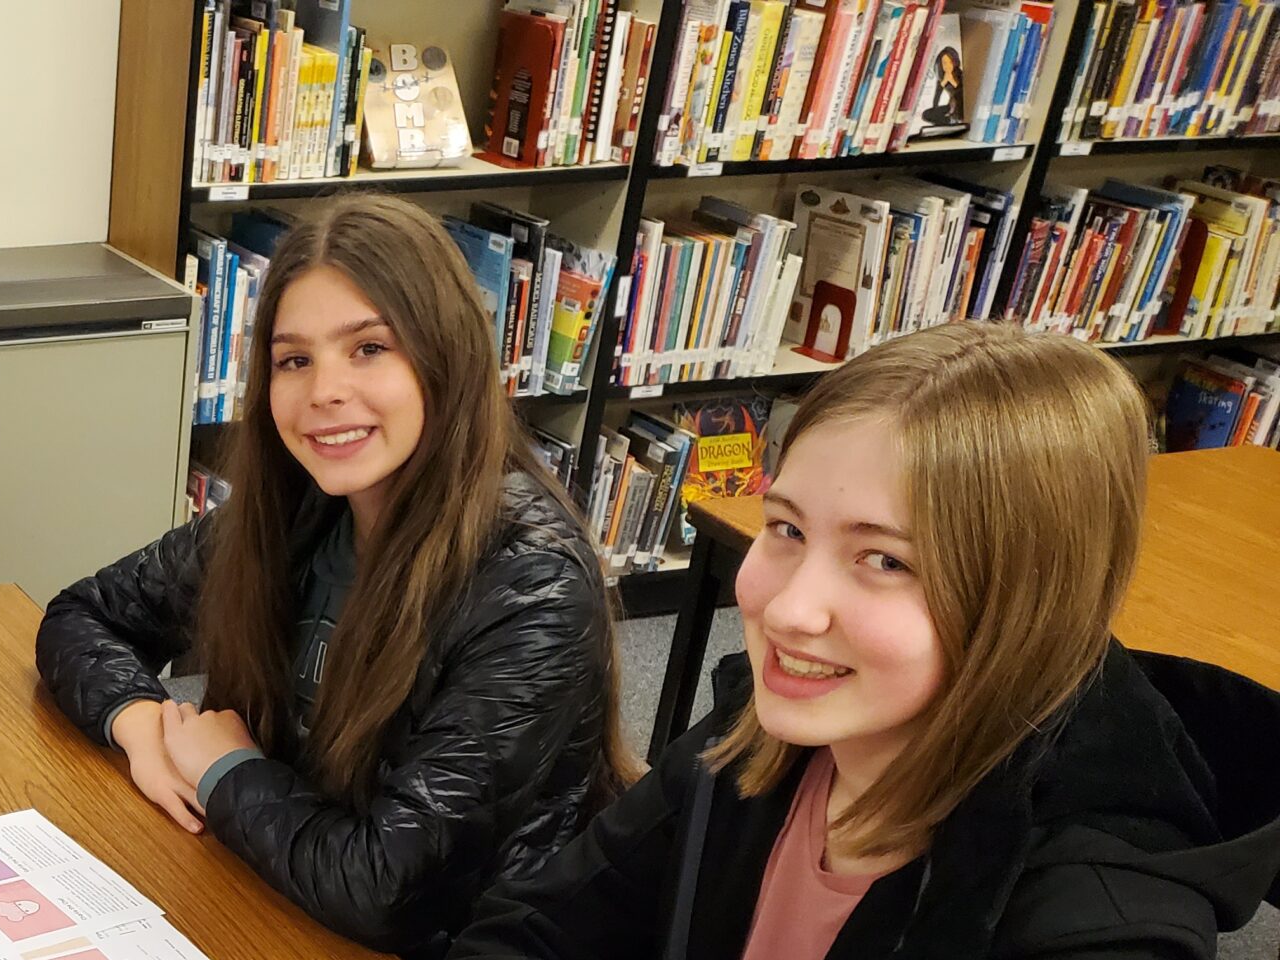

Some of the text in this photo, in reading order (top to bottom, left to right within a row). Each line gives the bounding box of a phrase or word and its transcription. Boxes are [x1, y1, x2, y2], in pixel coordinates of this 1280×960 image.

[735, 9, 748, 33] Blue
[728, 35, 741, 68] Zones
[236, 79, 245, 114] GENERATING
[719, 70, 735, 109] Kitchen
[216, 244, 225, 275] COMBAT
[213, 276, 222, 313] AIRCRAFT
[212, 315, 219, 325] OF
[527, 272, 542, 349] MODEL RAILROADS
[210, 327, 218, 354] WORLD
[208, 355, 216, 370] WAR
[700, 441, 751, 462] DRAGON
